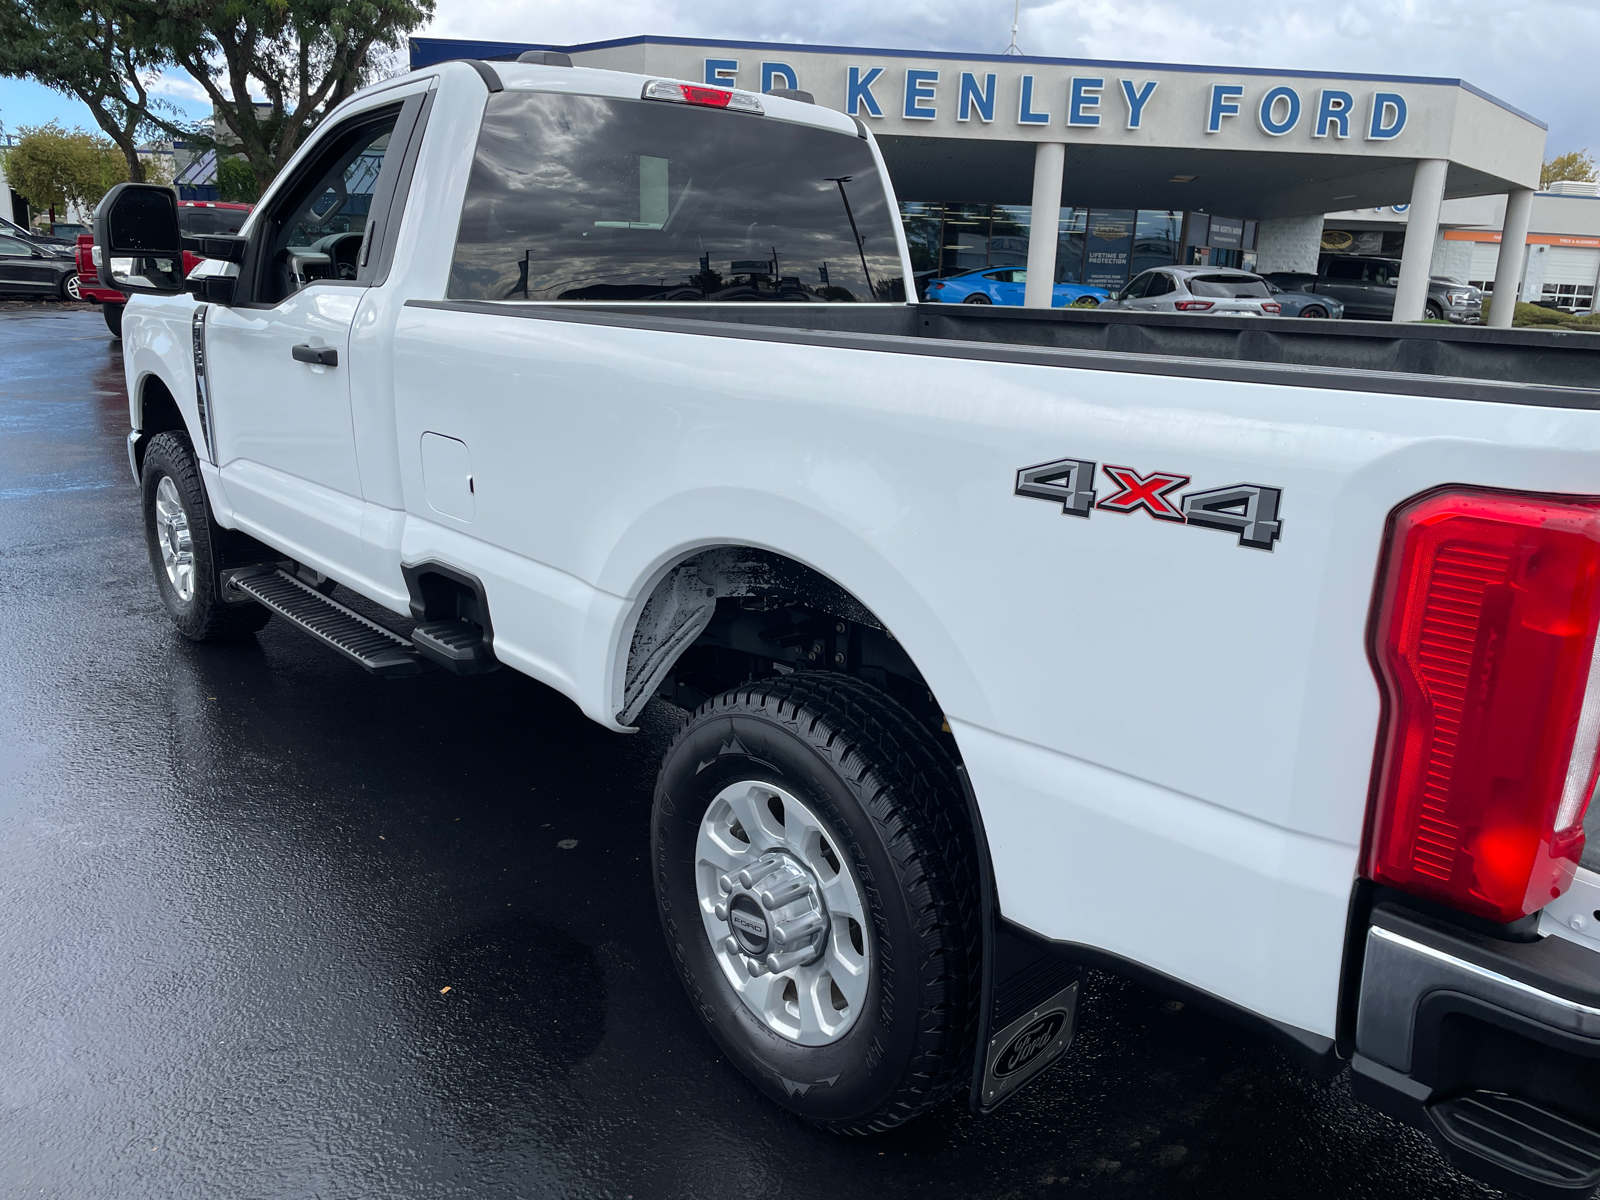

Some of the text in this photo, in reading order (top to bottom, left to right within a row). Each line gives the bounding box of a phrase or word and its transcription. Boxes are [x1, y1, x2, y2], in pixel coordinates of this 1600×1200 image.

[847, 65, 1159, 131] KENLEY
[1206, 83, 1409, 142] FORD
[734, 917, 763, 933] FORD
[1007, 1021, 1055, 1070] Ford
